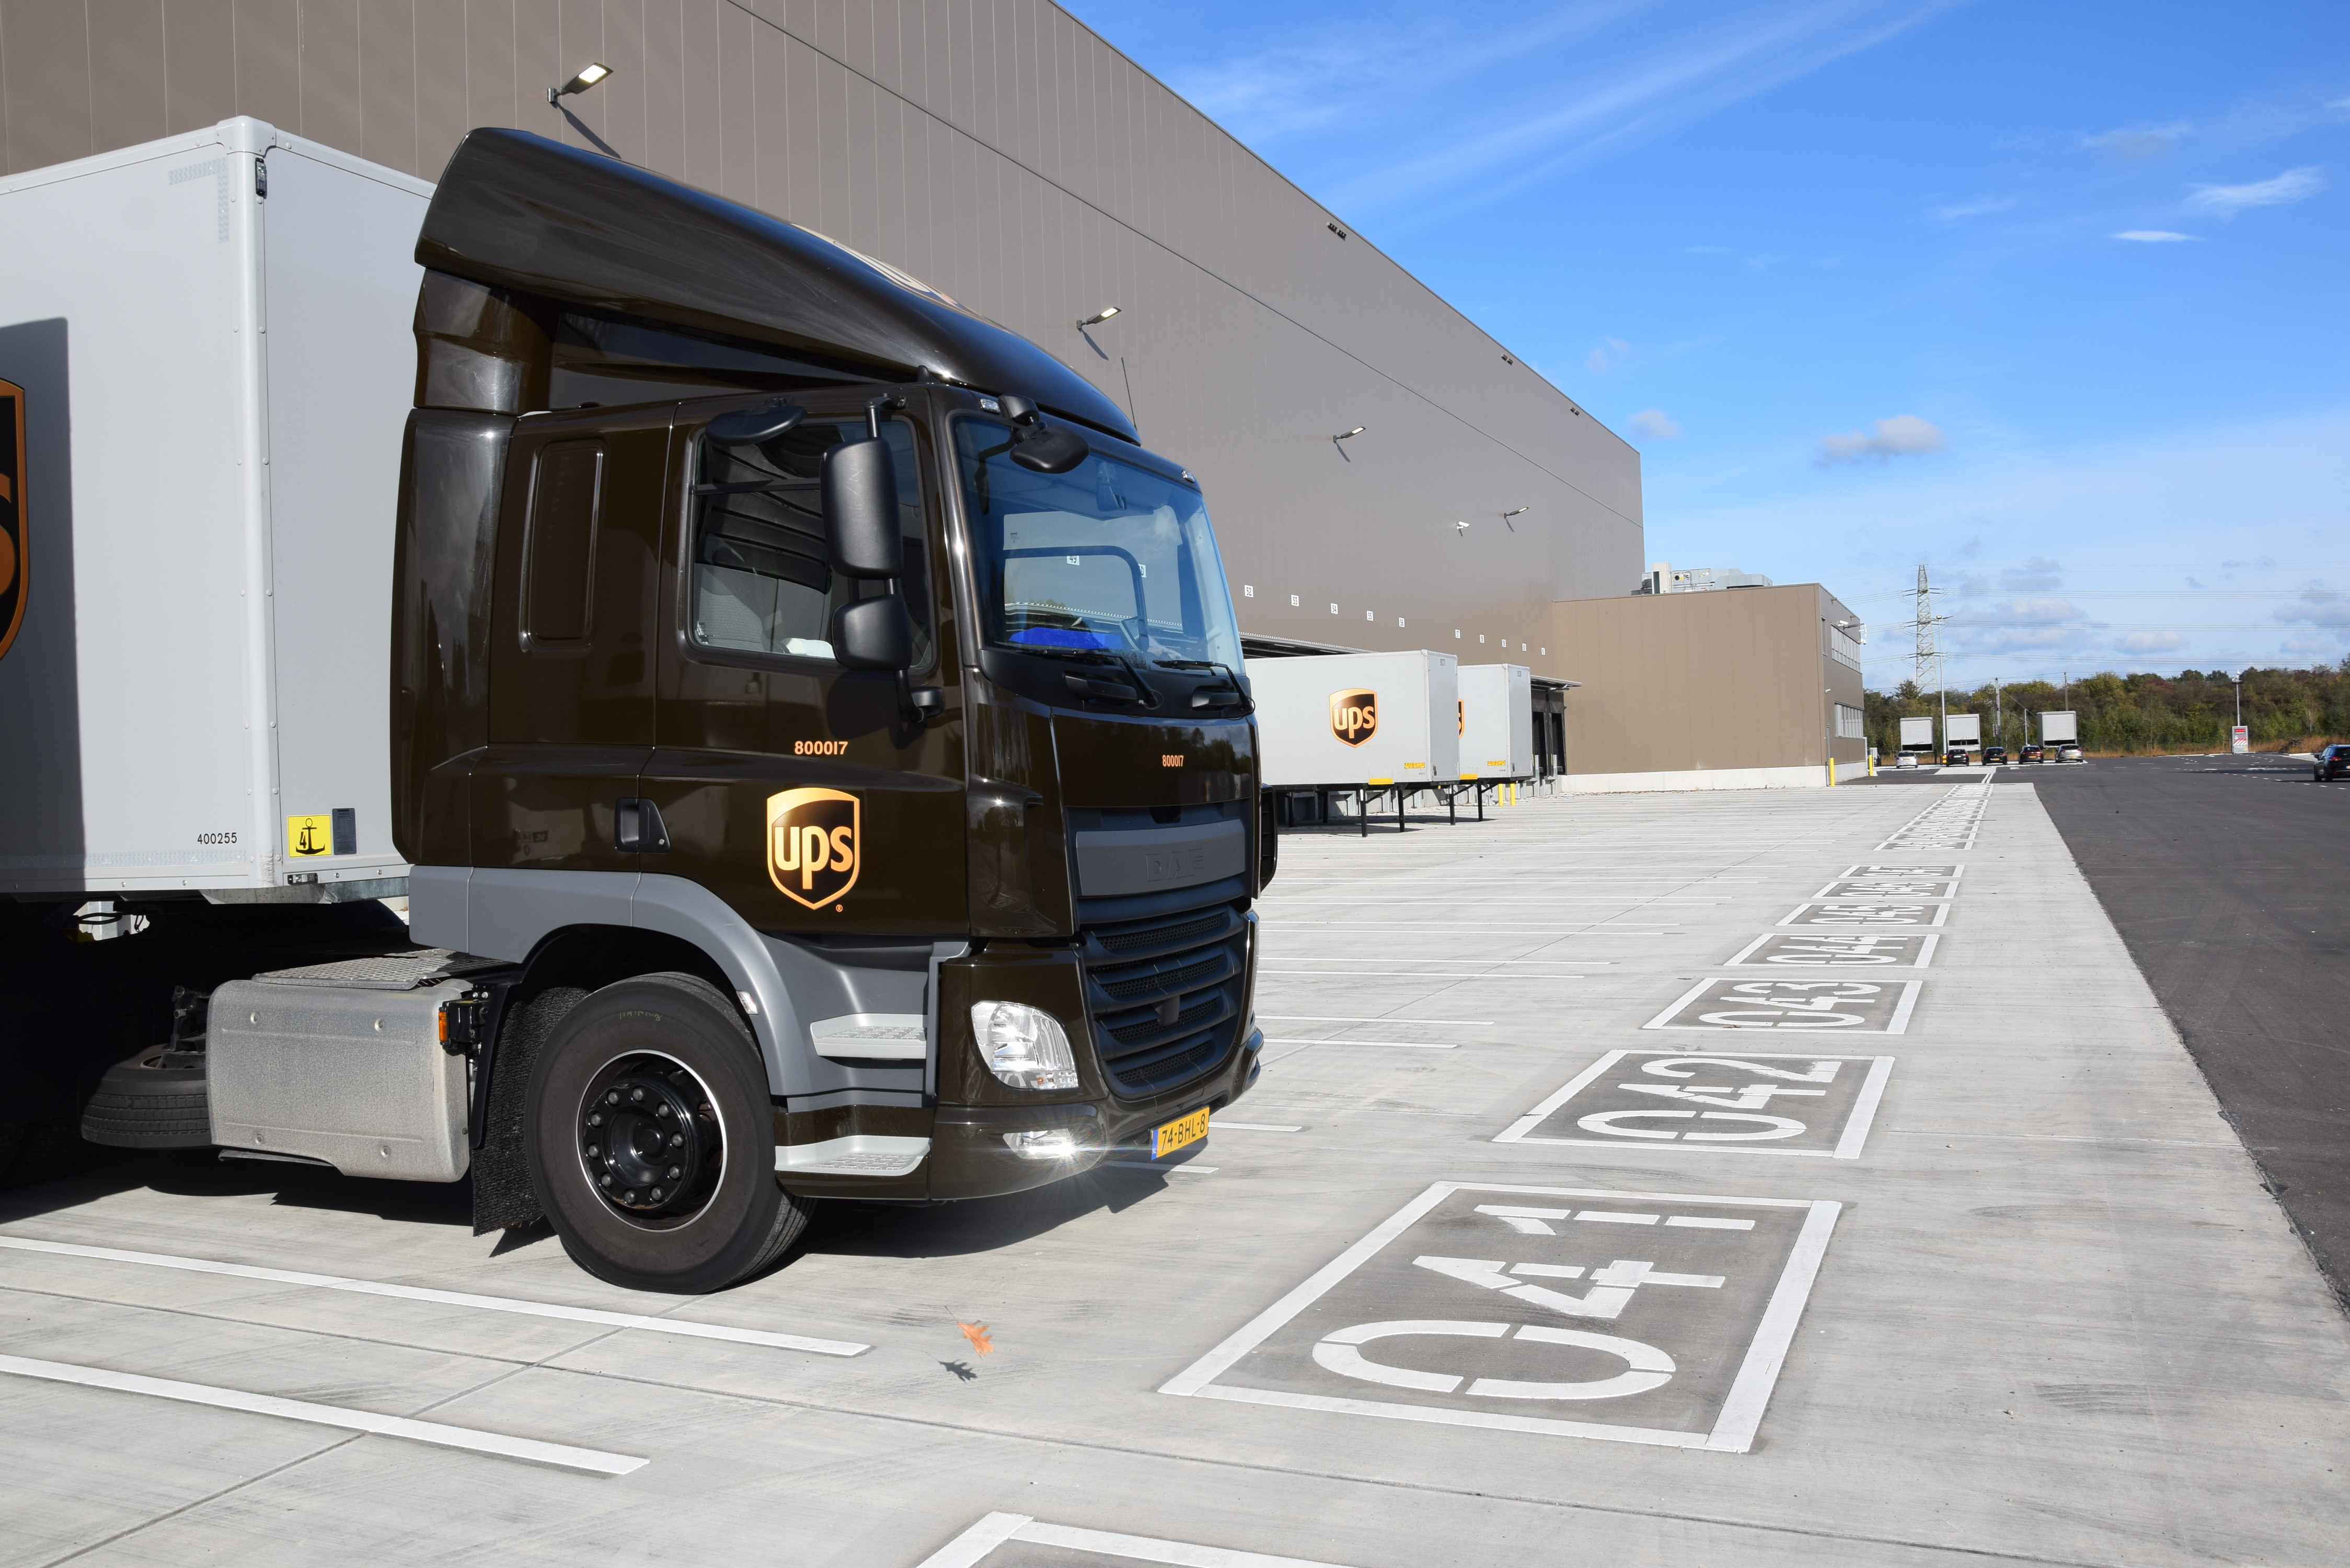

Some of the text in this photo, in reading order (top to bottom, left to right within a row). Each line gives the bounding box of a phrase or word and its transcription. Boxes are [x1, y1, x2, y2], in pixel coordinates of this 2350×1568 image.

[1246, 586, 1252, 596] 52
[1293, 596, 1298, 605] 53
[1332, 604, 1337, 613] 54
[1368, 612, 1373, 620] 55
[794, 741, 848, 755] 800017
[1162, 754, 1184, 767] 800017
[197, 832, 237, 845] 400255
[1146, 848, 1204, 882] DAF
[1862, 866, 1945, 877] 047
[1840, 882, 1937, 897] 046
[1810, 904, 1925, 925] 045
[1766, 936, 1908, 964] 044
[1698, 983, 1881, 1027] 043
[1577, 1058, 1842, 1141] 042
[1161, 1113, 1206, 1152] 74-BHL-8
[1312, 1204, 1756, 1400] 041
